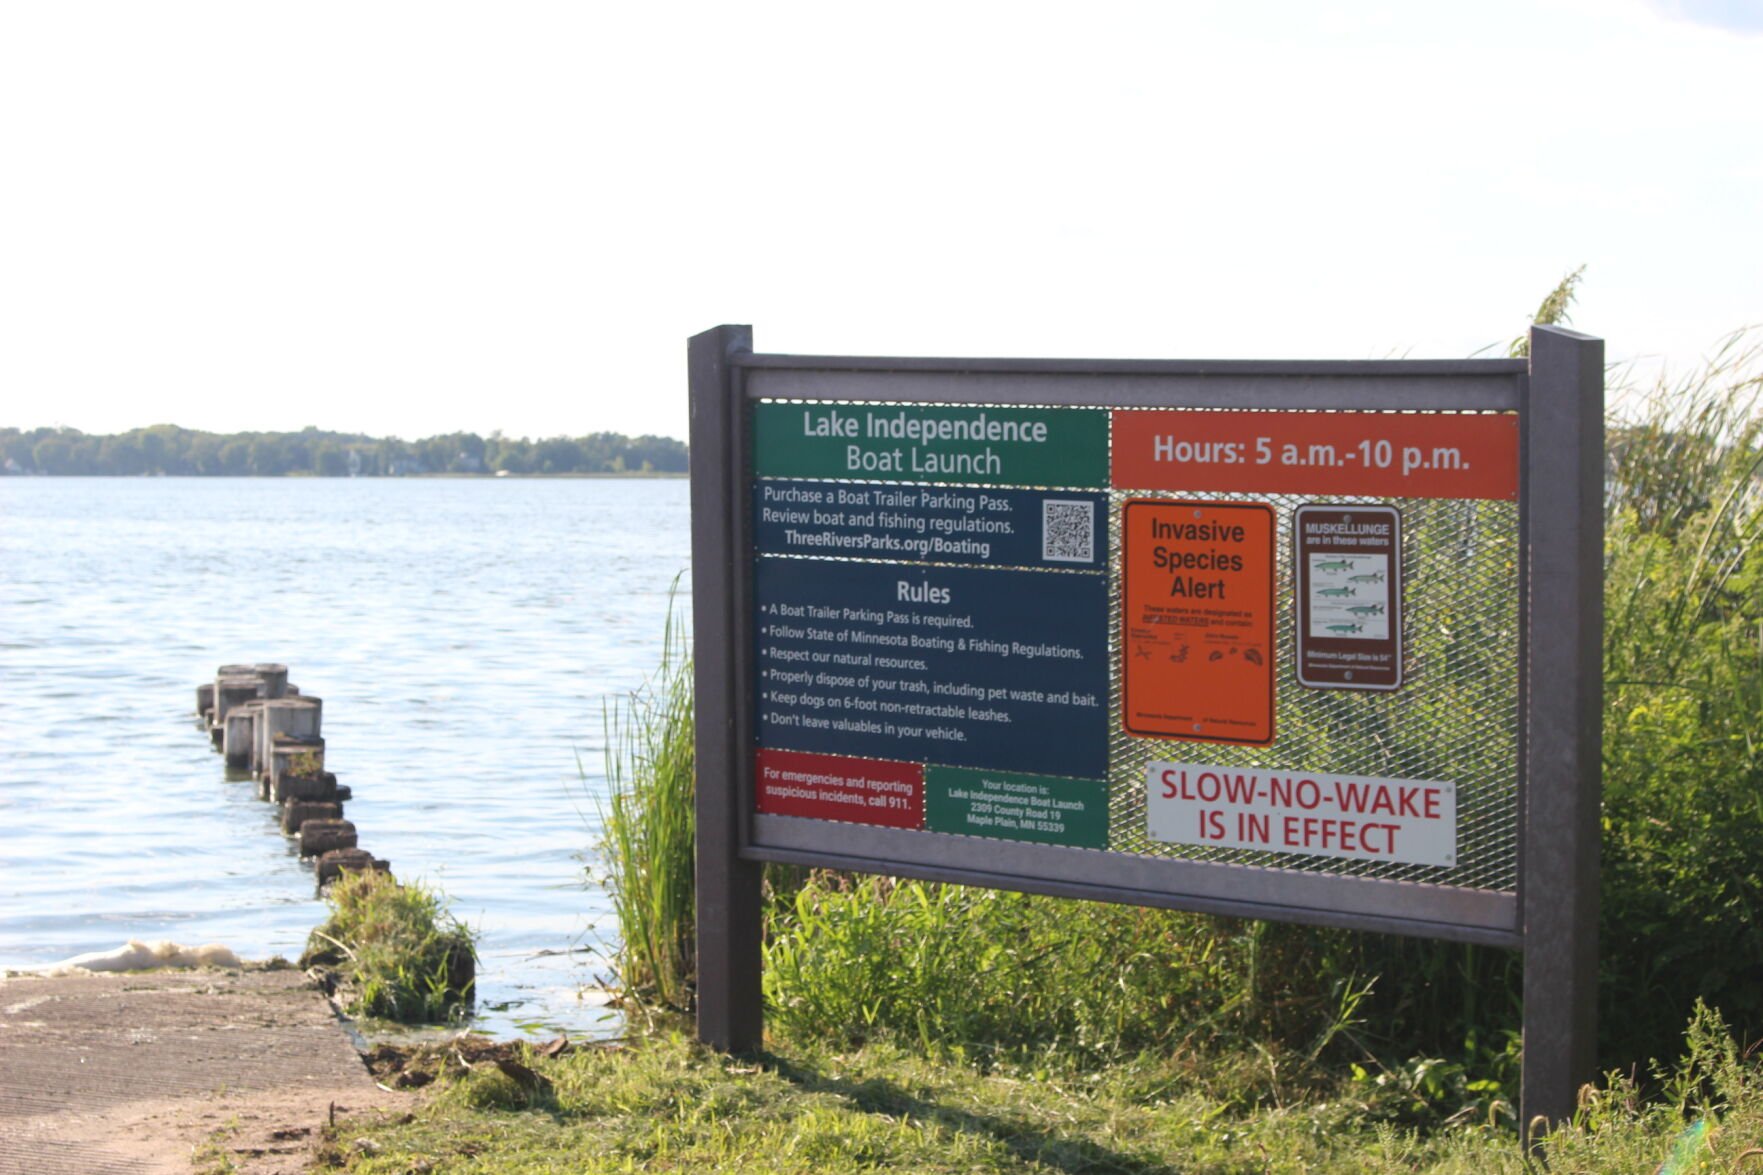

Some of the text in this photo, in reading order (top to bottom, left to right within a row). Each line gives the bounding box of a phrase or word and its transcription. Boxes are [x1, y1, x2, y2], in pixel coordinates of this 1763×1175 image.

[804, 411, 1047, 445] Lake Independence
[847, 446, 1001, 474] Boat Launch
[1154, 435, 1469, 475] Hours: 5 a.m.-10 p.m.
[764, 487, 1013, 513] Purchase a Boat Trailer Parking Pass.
[763, 508, 1014, 535] Review boat and fishing regulations.
[1152, 518, 1244, 542] Invasive
[1306, 523, 1389, 535] MUSKELLUNGE
[785, 530, 989, 558] ThreeRiversParks.org/Boating
[1322, 535, 1331, 544] in
[1333, 536, 1357, 545] these
[1359, 537, 1389, 546] waters
[1153, 547, 1243, 574] Species
[898, 581, 950, 604] Rules
[1171, 576, 1225, 599] Alert
[770, 604, 974, 629] A Boat Trailer Parking Pass is required.
[770, 626, 1083, 659] Follow State of Minnesota Boating & Fishing Regulations.
[770, 648, 928, 670] Respect our natural resources.
[771, 669, 1099, 707] Properly dispose of your trash, including pet waste and bait.
[771, 691, 1011, 723] Keep dogs on 6-foot non-retractable leashes.
[771, 713, 966, 742] Don't leave valuables in your vehicle.
[764, 767, 912, 795] For emergencies and reporting
[983, 780, 1049, 794] Your location is:
[766, 785, 911, 810] suspicious incidents, call 911.
[949, 788, 1084, 810] Lake Independence Boat Launch
[1161, 770, 1441, 819] SLOW-NO-WAKE
[967, 814, 1064, 832] Maple Plain, MN 55339
[971, 802, 1061, 820] 2309 County Road 19
[1200, 810, 1401, 854] IS IN EFFECT
